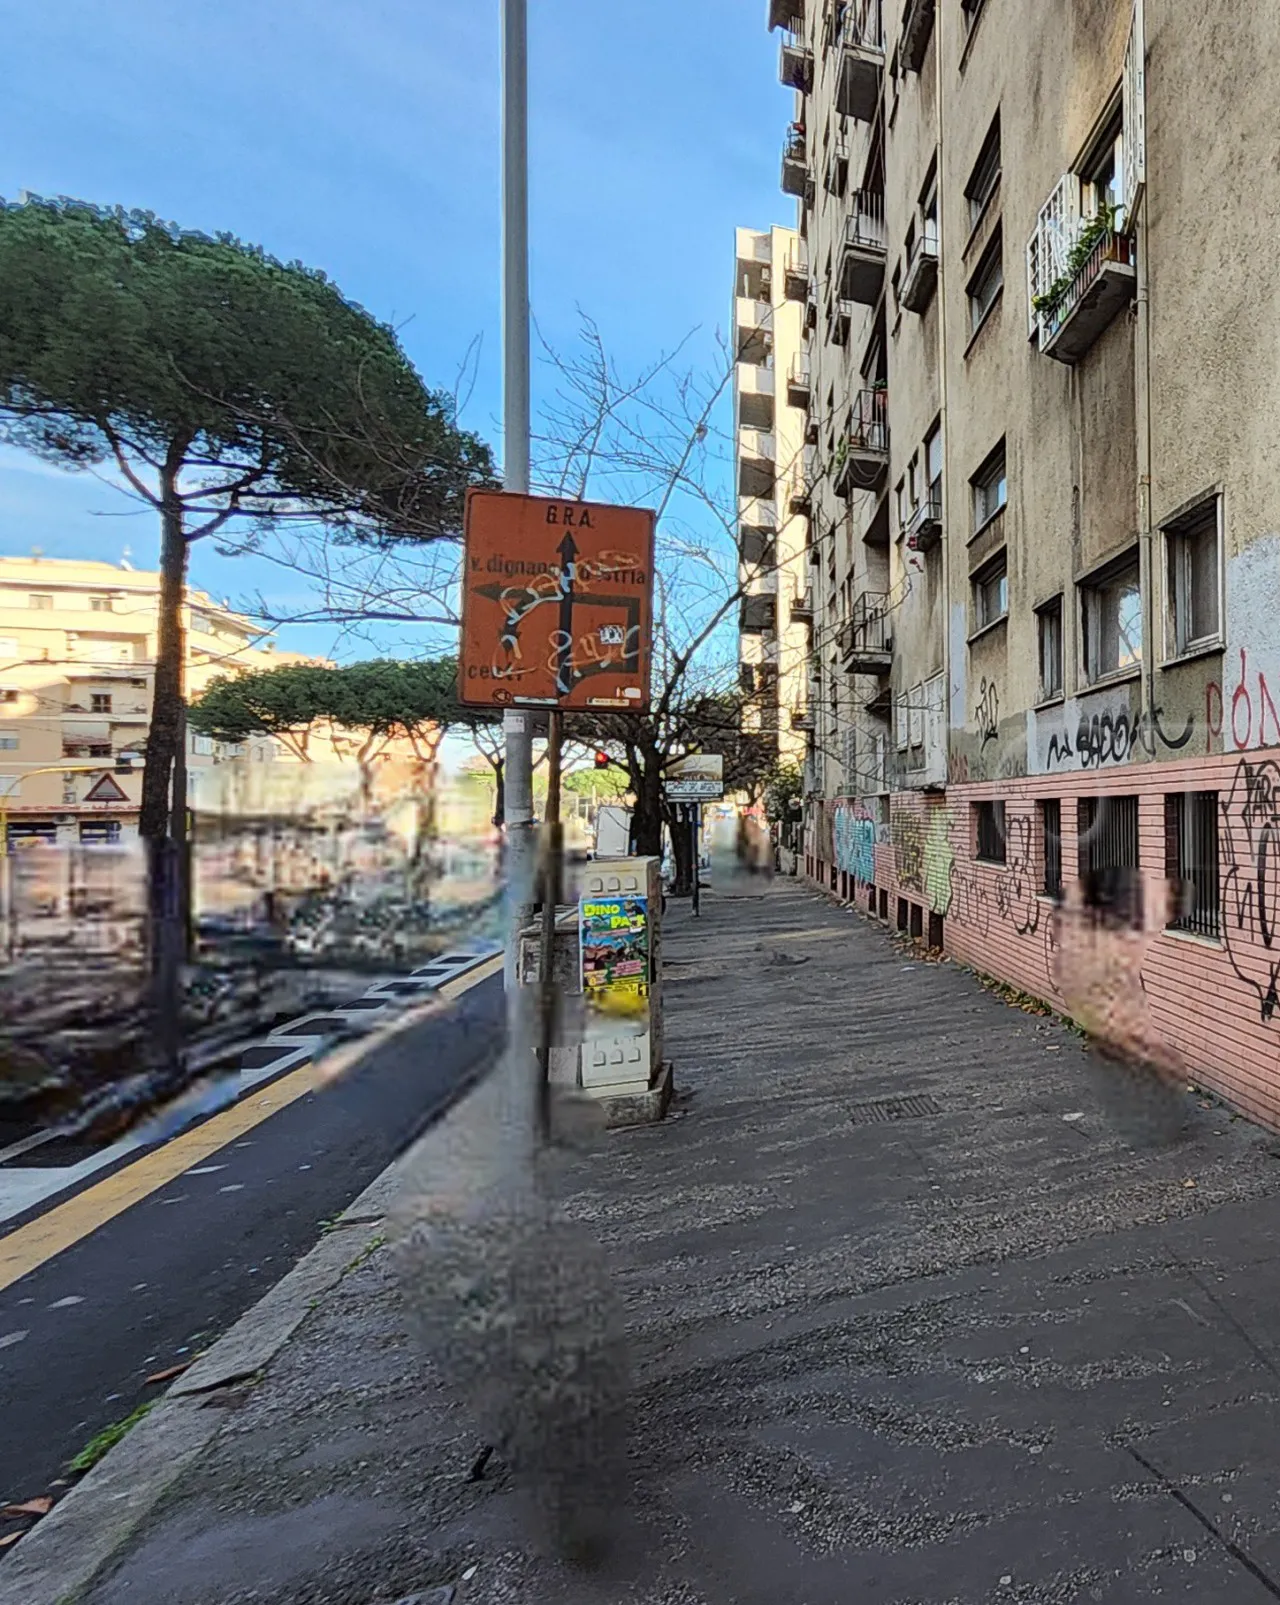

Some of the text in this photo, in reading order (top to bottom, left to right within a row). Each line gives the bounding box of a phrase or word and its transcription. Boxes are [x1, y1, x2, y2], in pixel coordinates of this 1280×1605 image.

[486, 553, 560, 577] dignan
[584, 904, 620, 917] DINO
[610, 914, 645, 928] PAK
